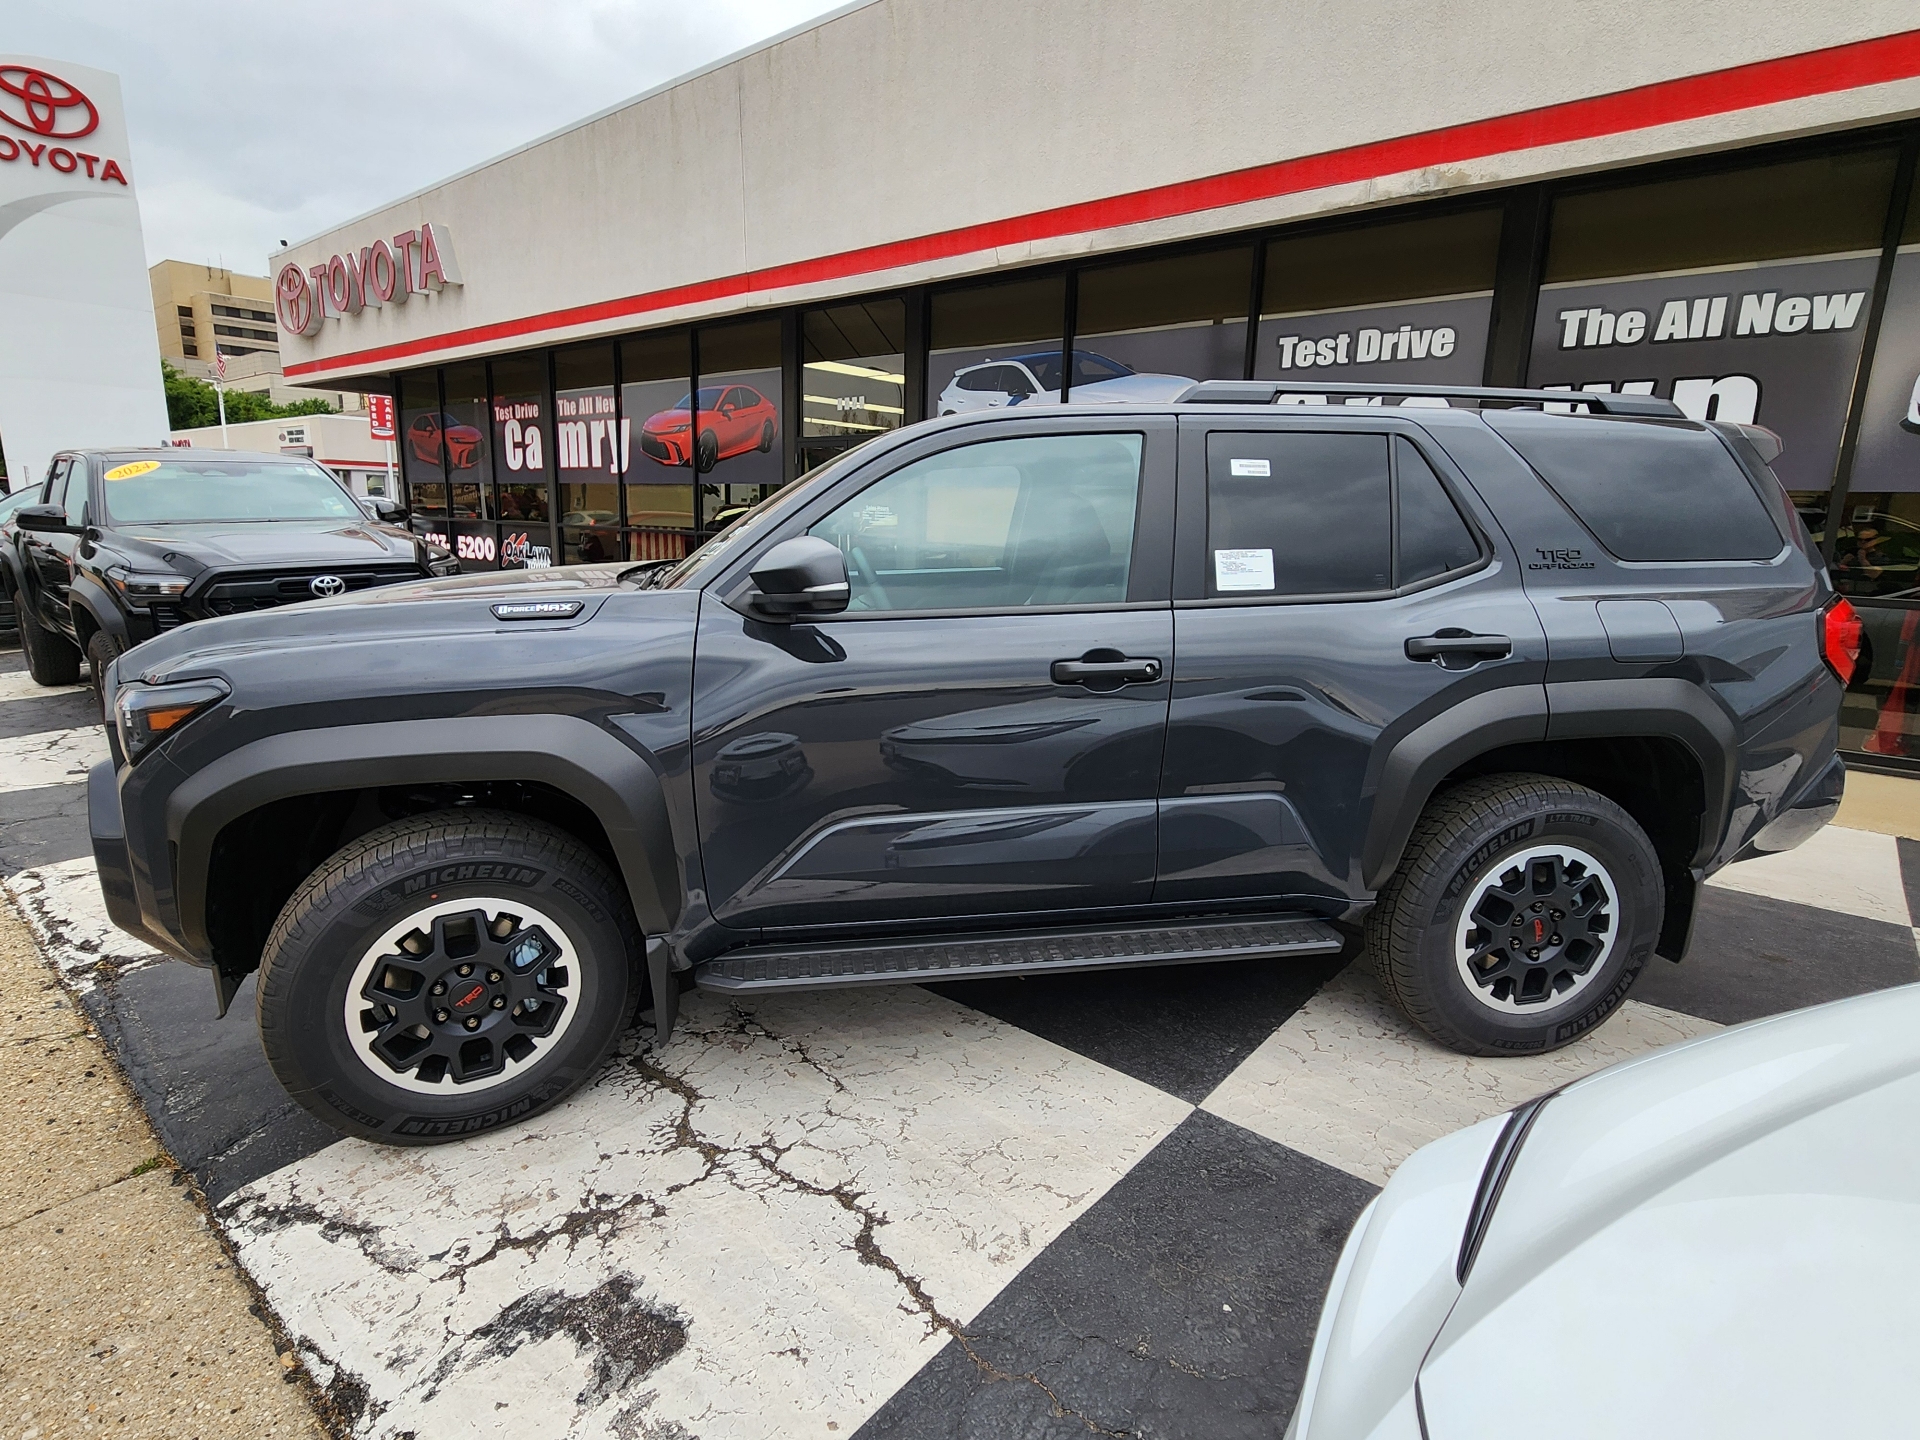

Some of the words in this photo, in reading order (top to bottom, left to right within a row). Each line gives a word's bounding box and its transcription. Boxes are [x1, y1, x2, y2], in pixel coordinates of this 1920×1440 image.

[0, 135, 128, 186] OYOTA
[309, 222, 448, 318] TOYOTA
[1560, 308, 1646, 348] The
[1654, 296, 1728, 341] All
[1736, 292, 1866, 336] New
[1279, 333, 1350, 368] Test
[1356, 326, 1456, 363] Drive
[370, 397, 379, 427] USED
[384, 398, 392, 428] CARS
[494, 405, 513, 421] Test
[515, 403, 539, 419] Drive
[558, 398, 577, 417] The
[579, 396, 593, 415] All
[114, 462, 151, 478] 2024
[1536, 548, 1582, 563] TRD
[1550, 814, 1567, 822] LTX
[1570, 814, 1591, 824] TRAIL
[1451, 823, 1531, 892] MICHELIN
[403, 864, 538, 895] MICHELIN
[455, 985, 483, 1007] TRD
[1559, 973, 1634, 1040] MICHELIN
[401, 1098, 531, 1134] MICHELIN
